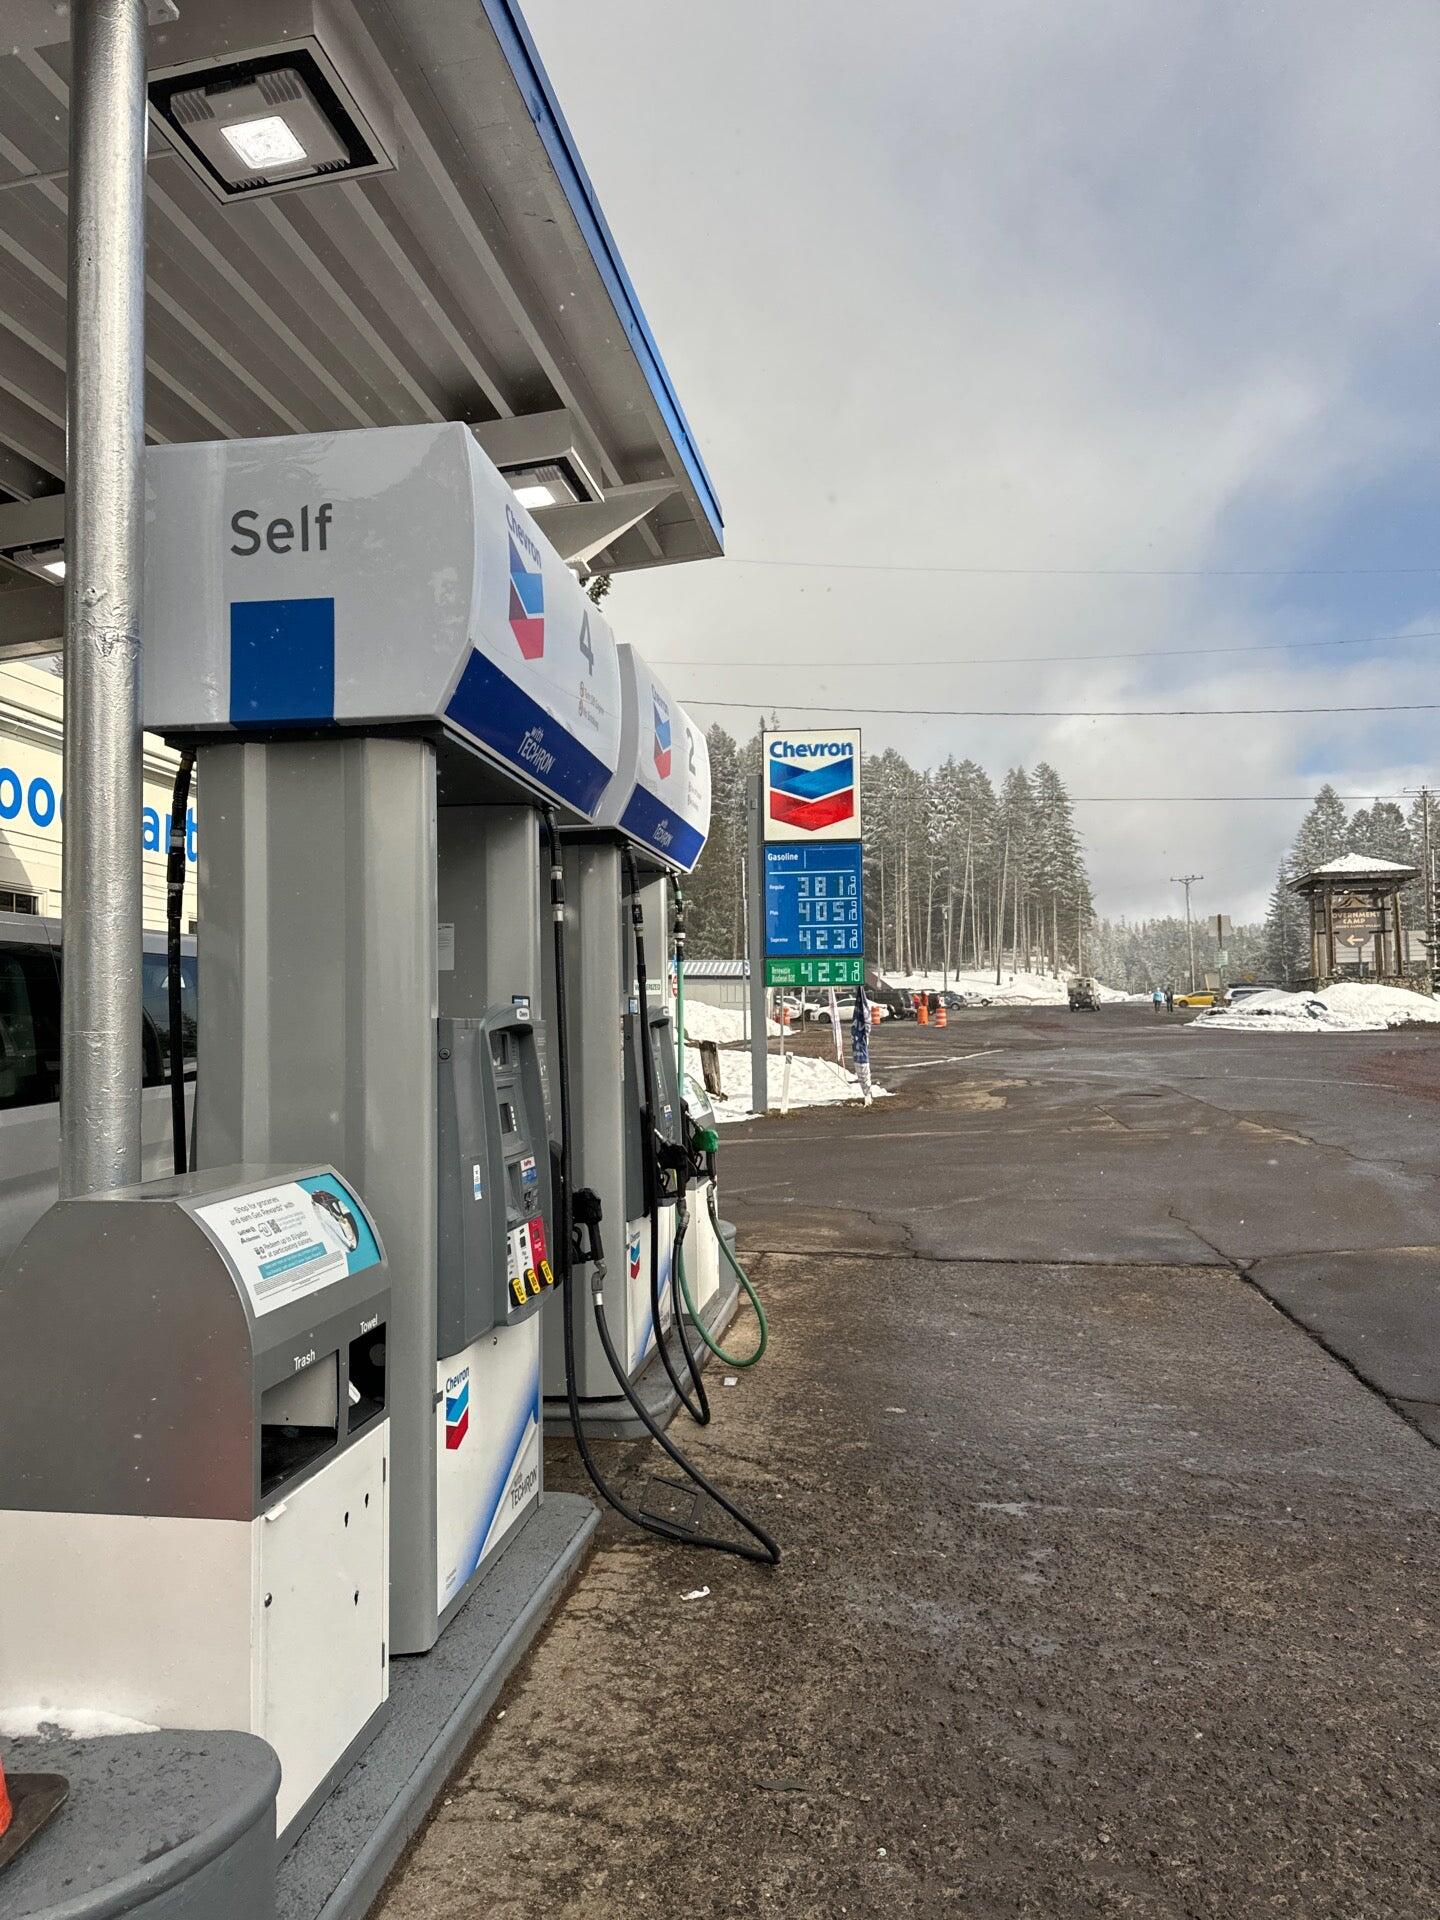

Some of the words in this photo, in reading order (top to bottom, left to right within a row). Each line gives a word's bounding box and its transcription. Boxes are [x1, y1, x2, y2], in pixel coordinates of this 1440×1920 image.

[230, 503, 333, 556] Self
[505, 503, 542, 569] Chevron
[579, 609, 594, 677] 4
[530, 726, 544, 743] with
[686, 727, 696, 776] 2
[769, 740, 853, 758] Chevron
[517, 731, 556, 774] TECHRON
[0, 767, 63, 828] oo
[767, 852, 799, 861] Gasoline
[1332, 911, 1380, 919] OVERNMENT
[360, 1313, 378, 1334] Towel
[293, 1349, 316, 1371] Trash
[446, 1366, 469, 1393] Chevron
[511, 1468, 538, 1509] TECHRON
